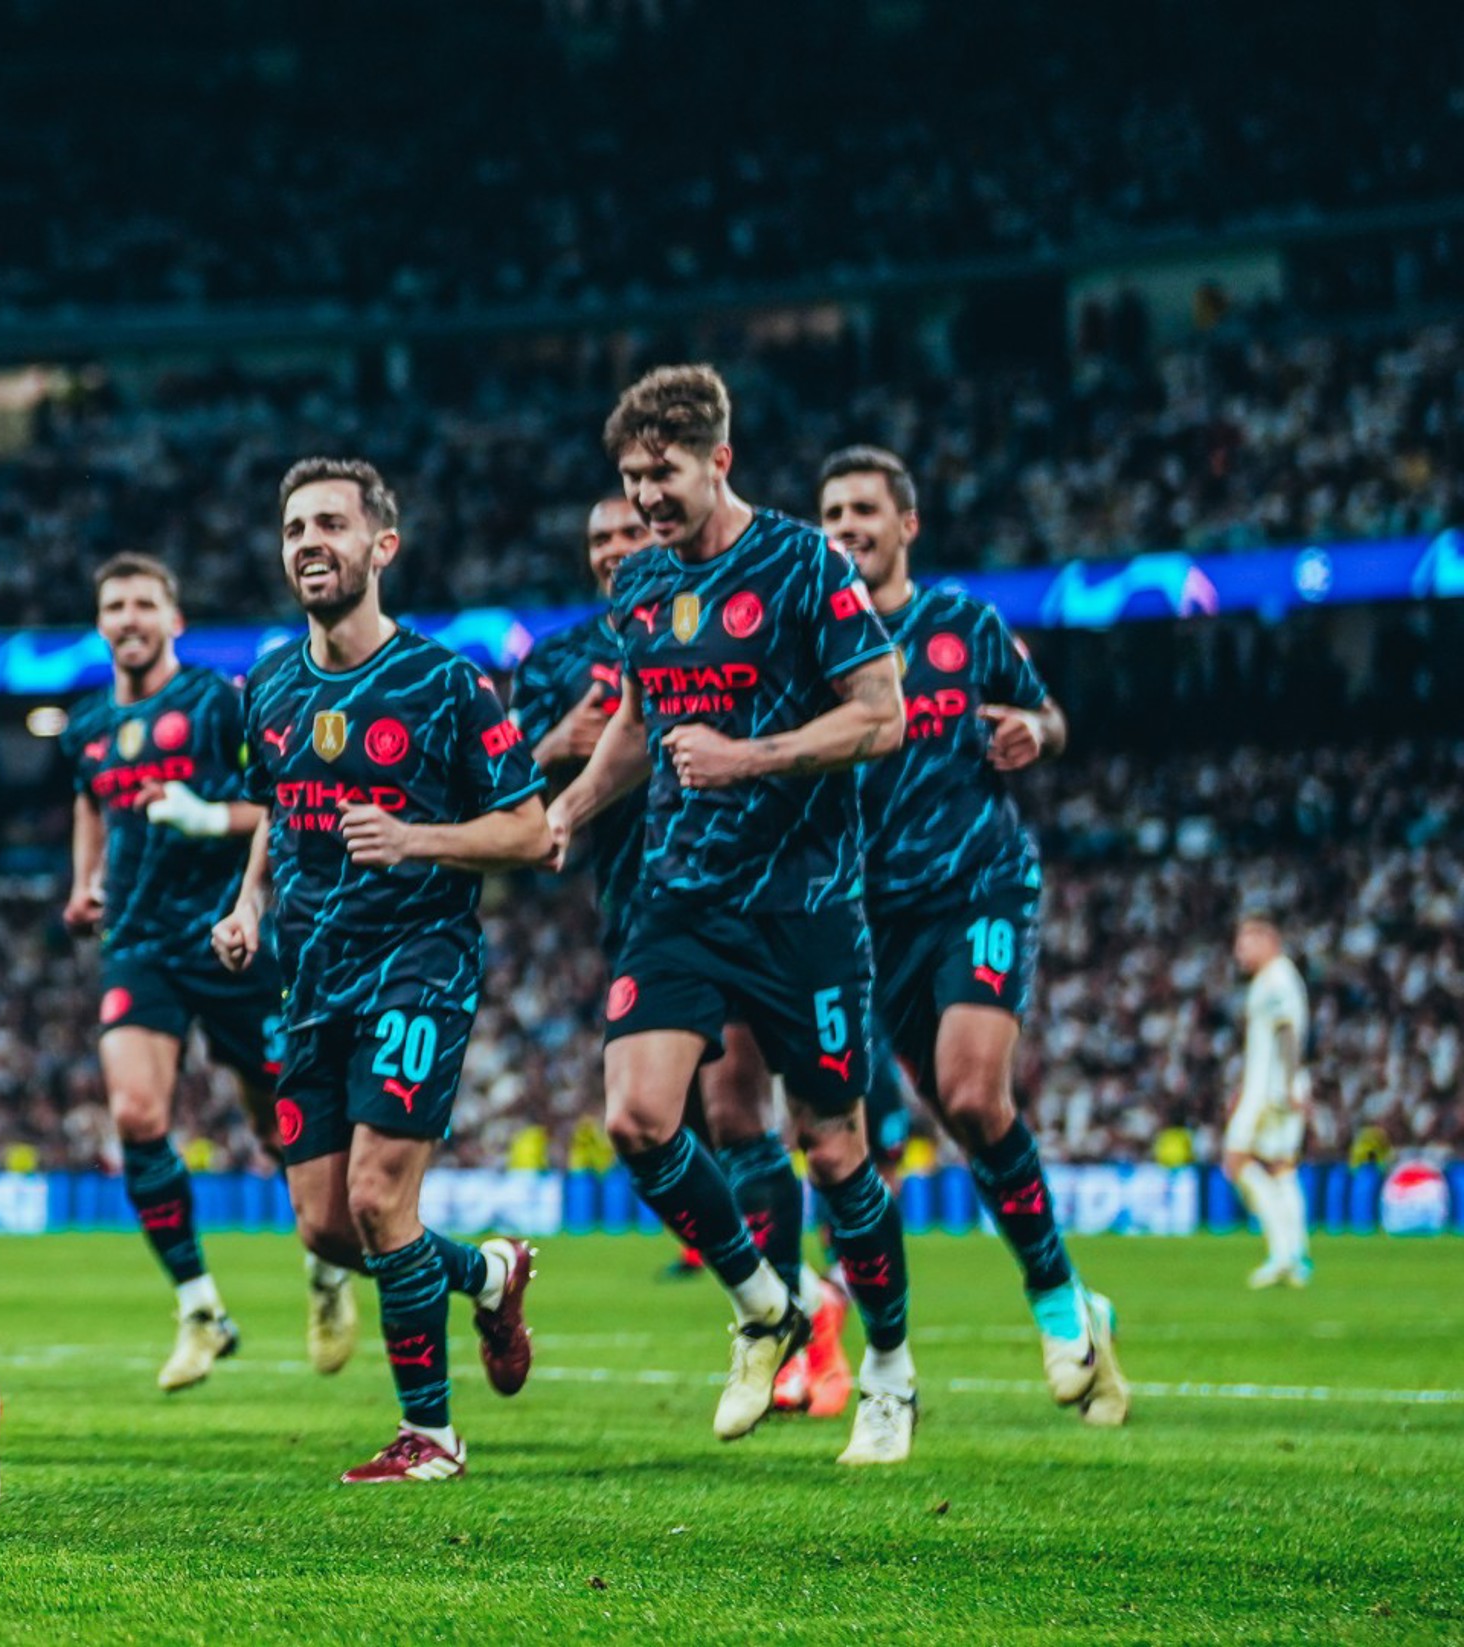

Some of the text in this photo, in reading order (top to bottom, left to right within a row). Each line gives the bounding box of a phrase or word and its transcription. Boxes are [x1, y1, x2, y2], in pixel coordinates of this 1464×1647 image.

[276, 779, 407, 812] ETIHAD
[372, 1009, 437, 1083] 20
[814, 985, 847, 1054] 5
